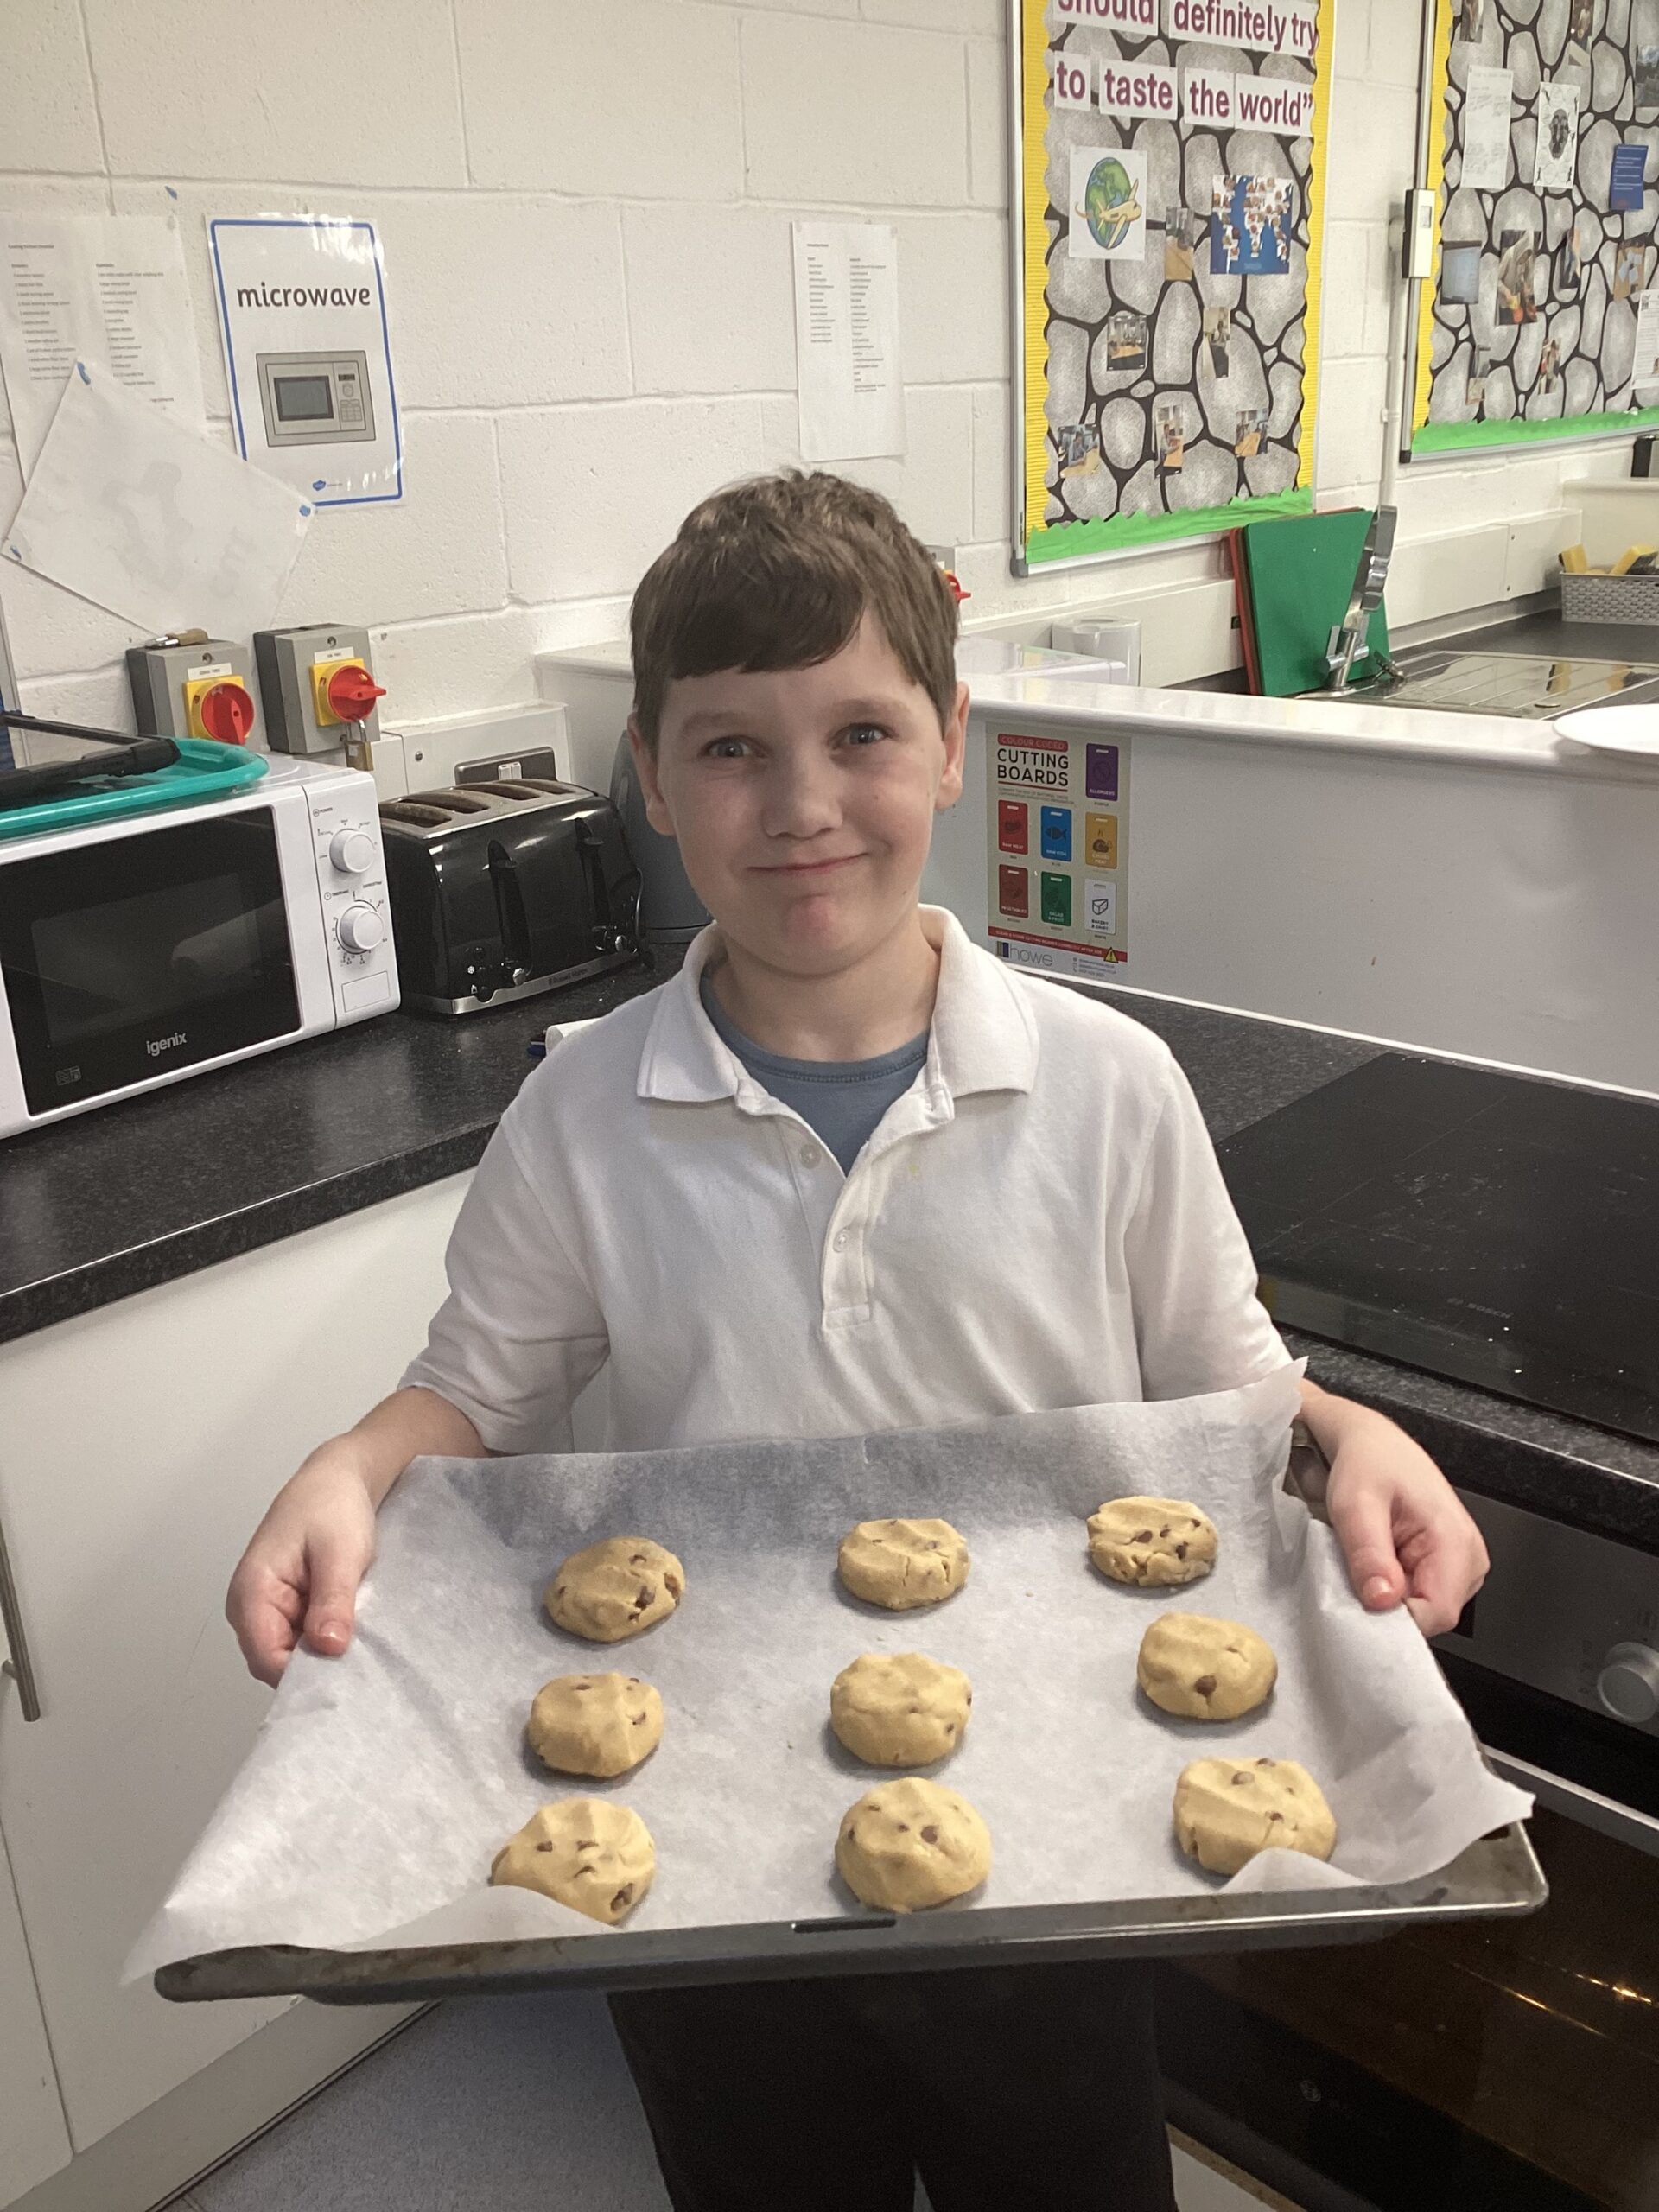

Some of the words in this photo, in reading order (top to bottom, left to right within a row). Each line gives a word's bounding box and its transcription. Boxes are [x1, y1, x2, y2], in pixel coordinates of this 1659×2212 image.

[1174, 0, 1287, 52] definitely
[1291, 13, 1319, 57] try
[1057, 61, 1086, 99] to
[1104, 68, 1173, 110] taste
[1190, 78, 1230, 118] the
[237, 281, 372, 308] microwave
[1001, 735, 1034, 746] COLOUR
[997, 748, 1069, 769] CUTTING
[997, 765, 1069, 786] BOARDS
[1010, 940, 1054, 967] howe
[146, 1032, 188, 1057] igenix
